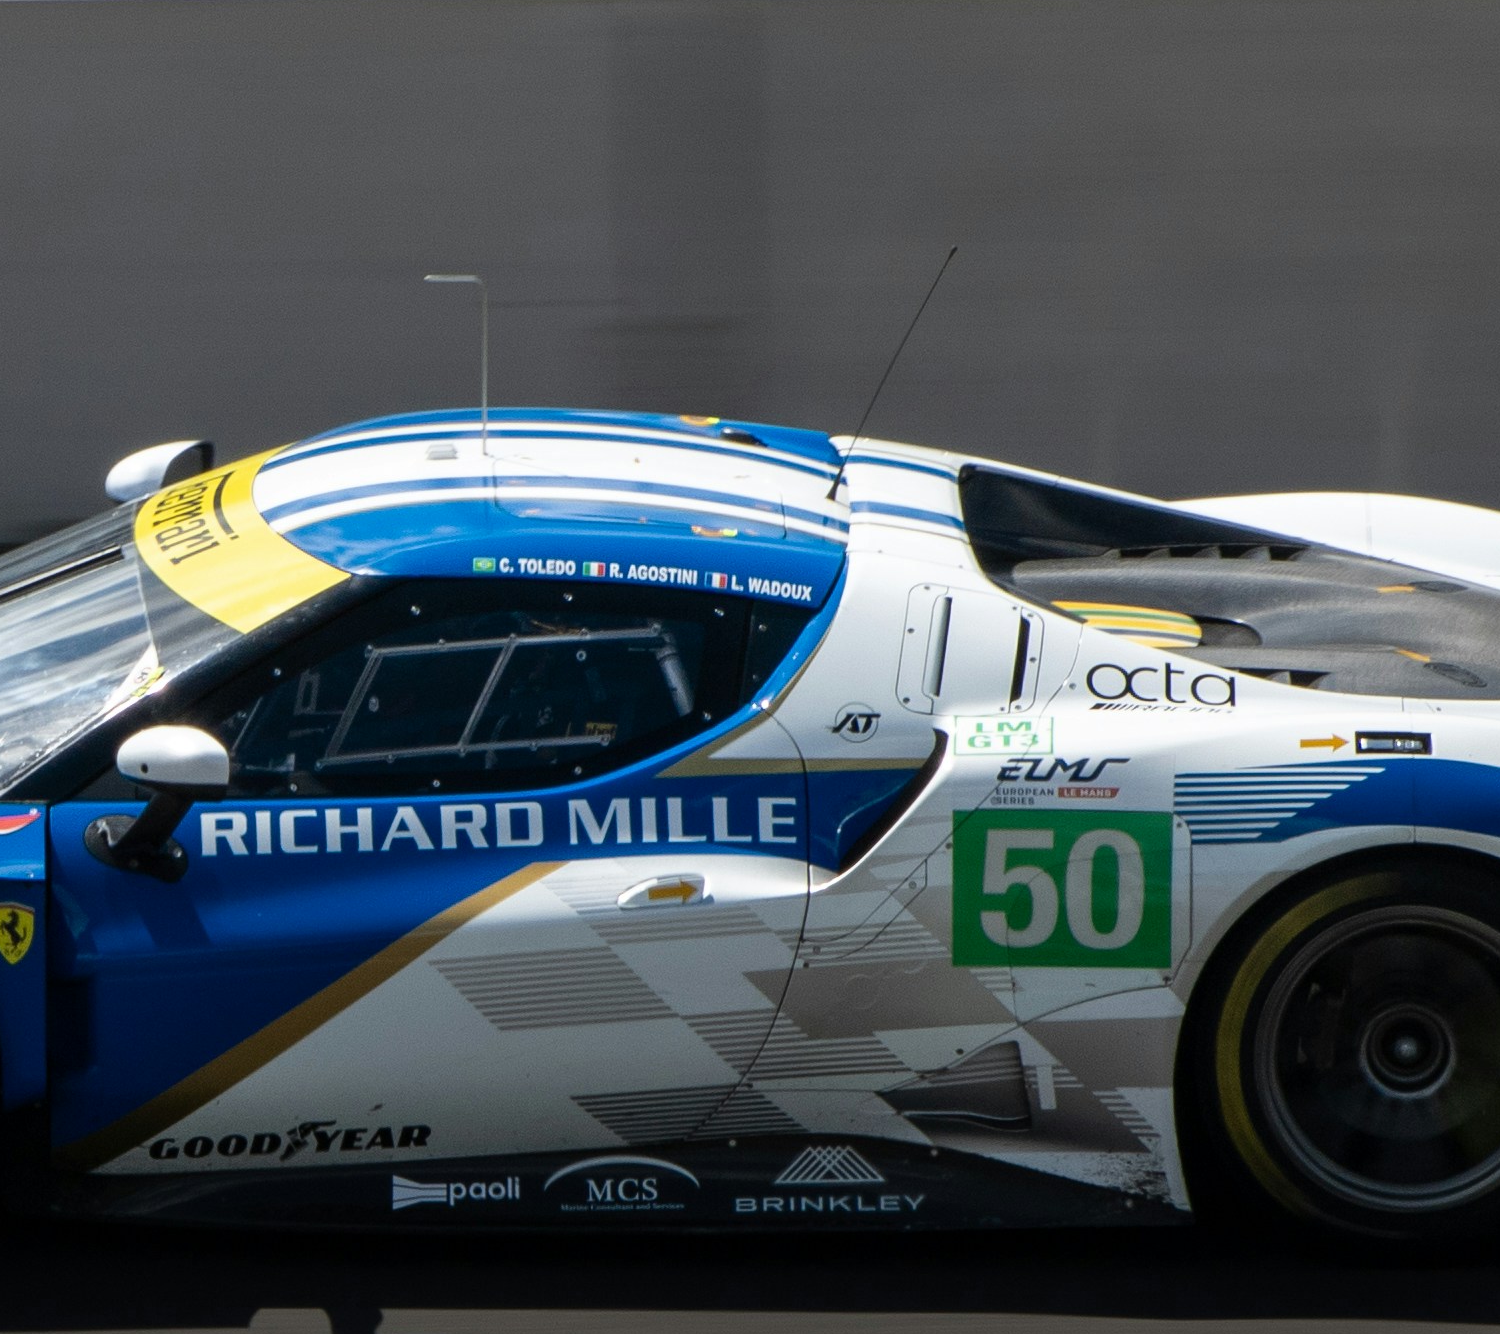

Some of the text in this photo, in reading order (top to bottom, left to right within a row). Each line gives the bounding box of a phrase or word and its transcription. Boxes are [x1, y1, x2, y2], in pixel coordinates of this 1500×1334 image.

[499, 557, 813, 602] C. TOLEDO R. AGOSTINI L. WADOUX
[1086, 661, 1236, 707] octa
[975, 721, 1032, 733] LM
[967, 733, 1039, 748] GT3
[995, 787, 1111, 798] EUROPEAN LE MANS
[996, 796, 1035, 806] SERIES
[200, 796, 797, 856] RICHARD MILLE
[979, 827, 1145, 950] 50
[449, 1176, 520, 1207] paoli
[586, 1177, 659, 1203] MCS
[735, 1194, 925, 1213] BRINKLEY
